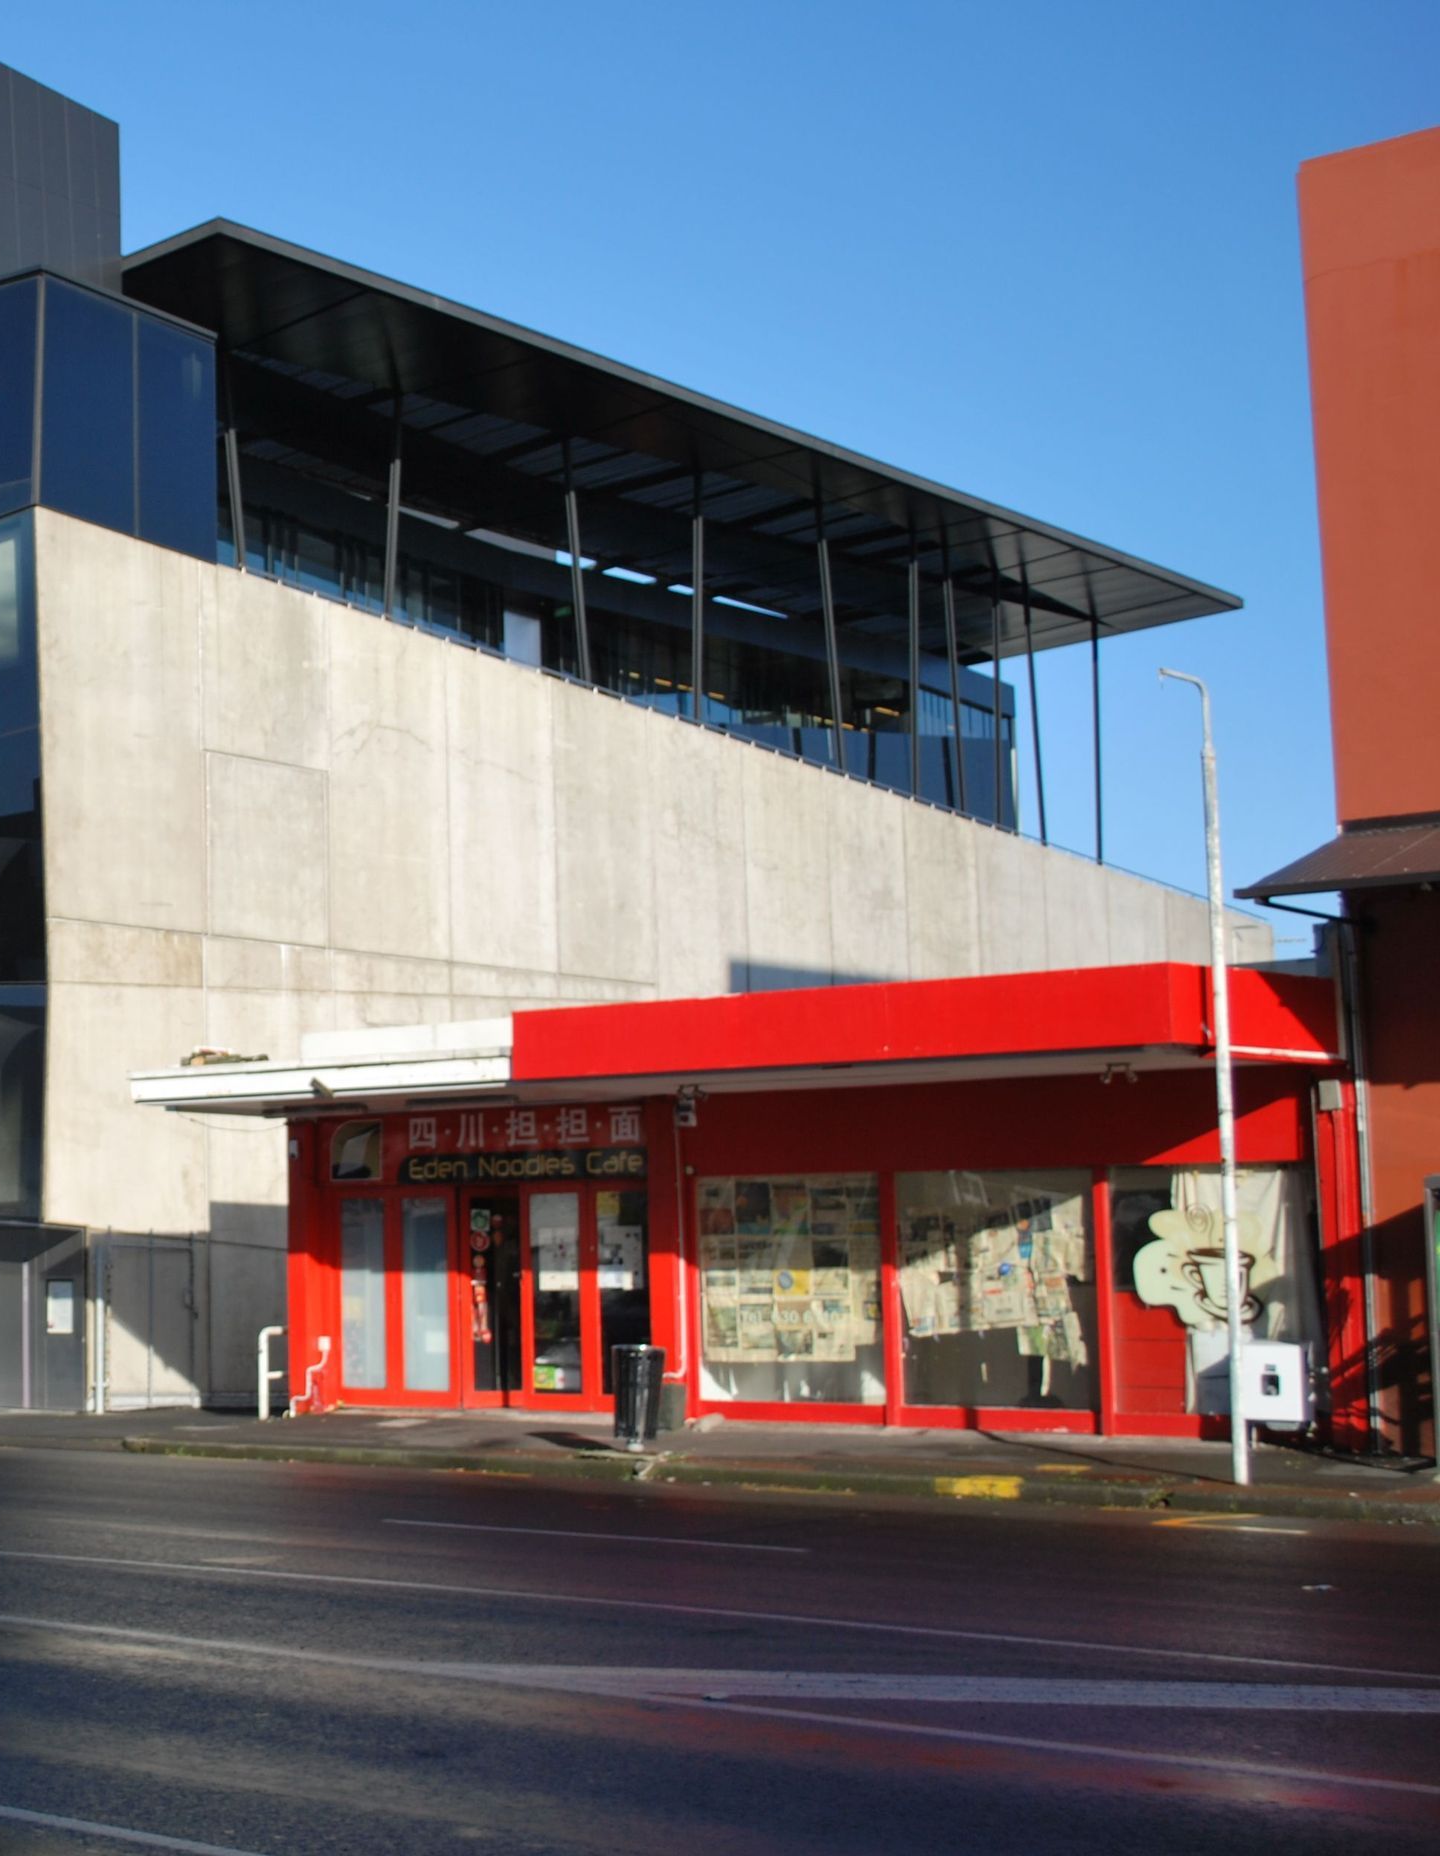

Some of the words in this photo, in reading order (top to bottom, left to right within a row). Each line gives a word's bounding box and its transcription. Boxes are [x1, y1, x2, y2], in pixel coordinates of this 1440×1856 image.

[409, 1155, 469, 1180] Eden
[479, 1154, 576, 1177] Noodles
[586, 1151, 643, 1175] Cafe
